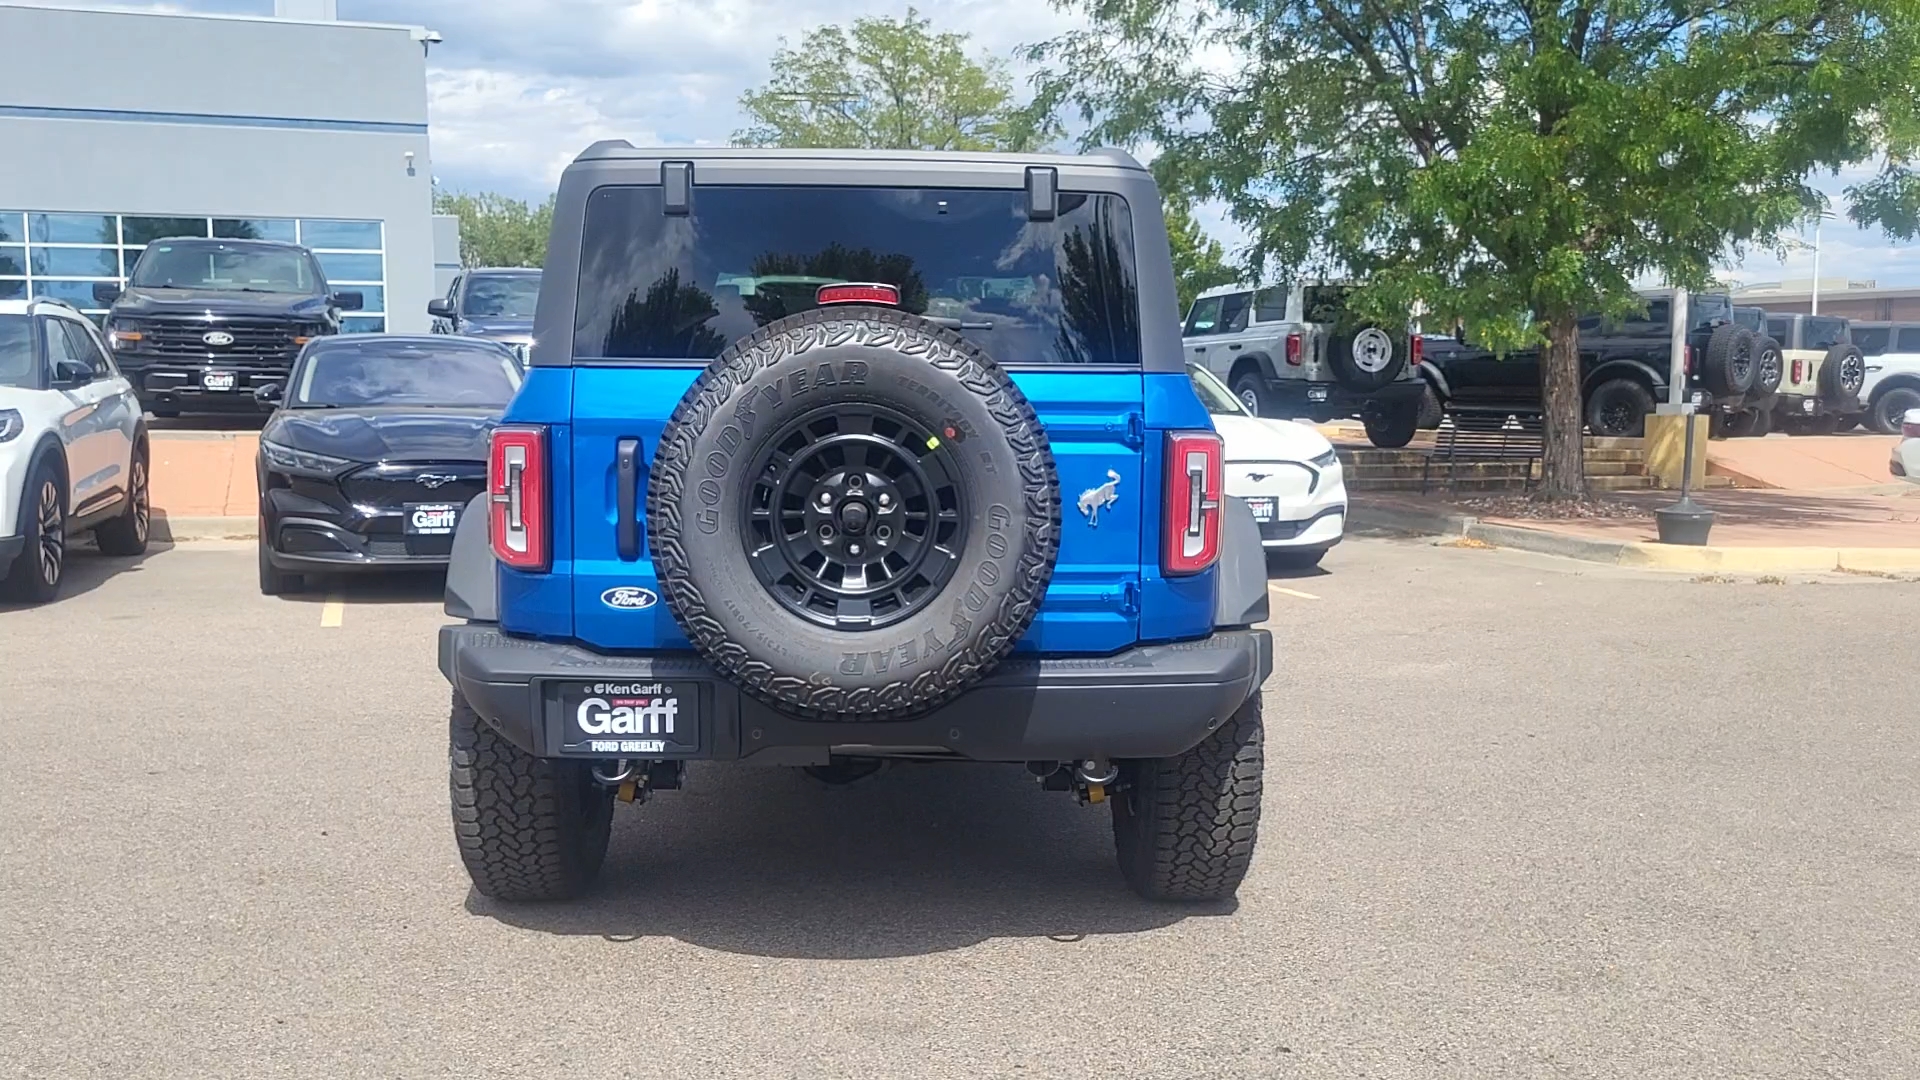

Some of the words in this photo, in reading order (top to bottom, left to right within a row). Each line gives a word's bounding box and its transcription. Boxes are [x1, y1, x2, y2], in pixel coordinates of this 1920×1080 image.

[696, 360, 870, 535] GOODYEAR
[1248, 503, 1273, 517] arff
[412, 510, 456, 528] Garff
[611, 590, 648, 606] Ford
[838, 502, 1012, 677] GOODYEAR
[605, 683, 629, 695] Ken
[631, 683, 663, 695] Garff
[577, 697, 678, 735] Garff
[591, 741, 619, 753] FORD
[620, 741, 666, 753] GREELEY
